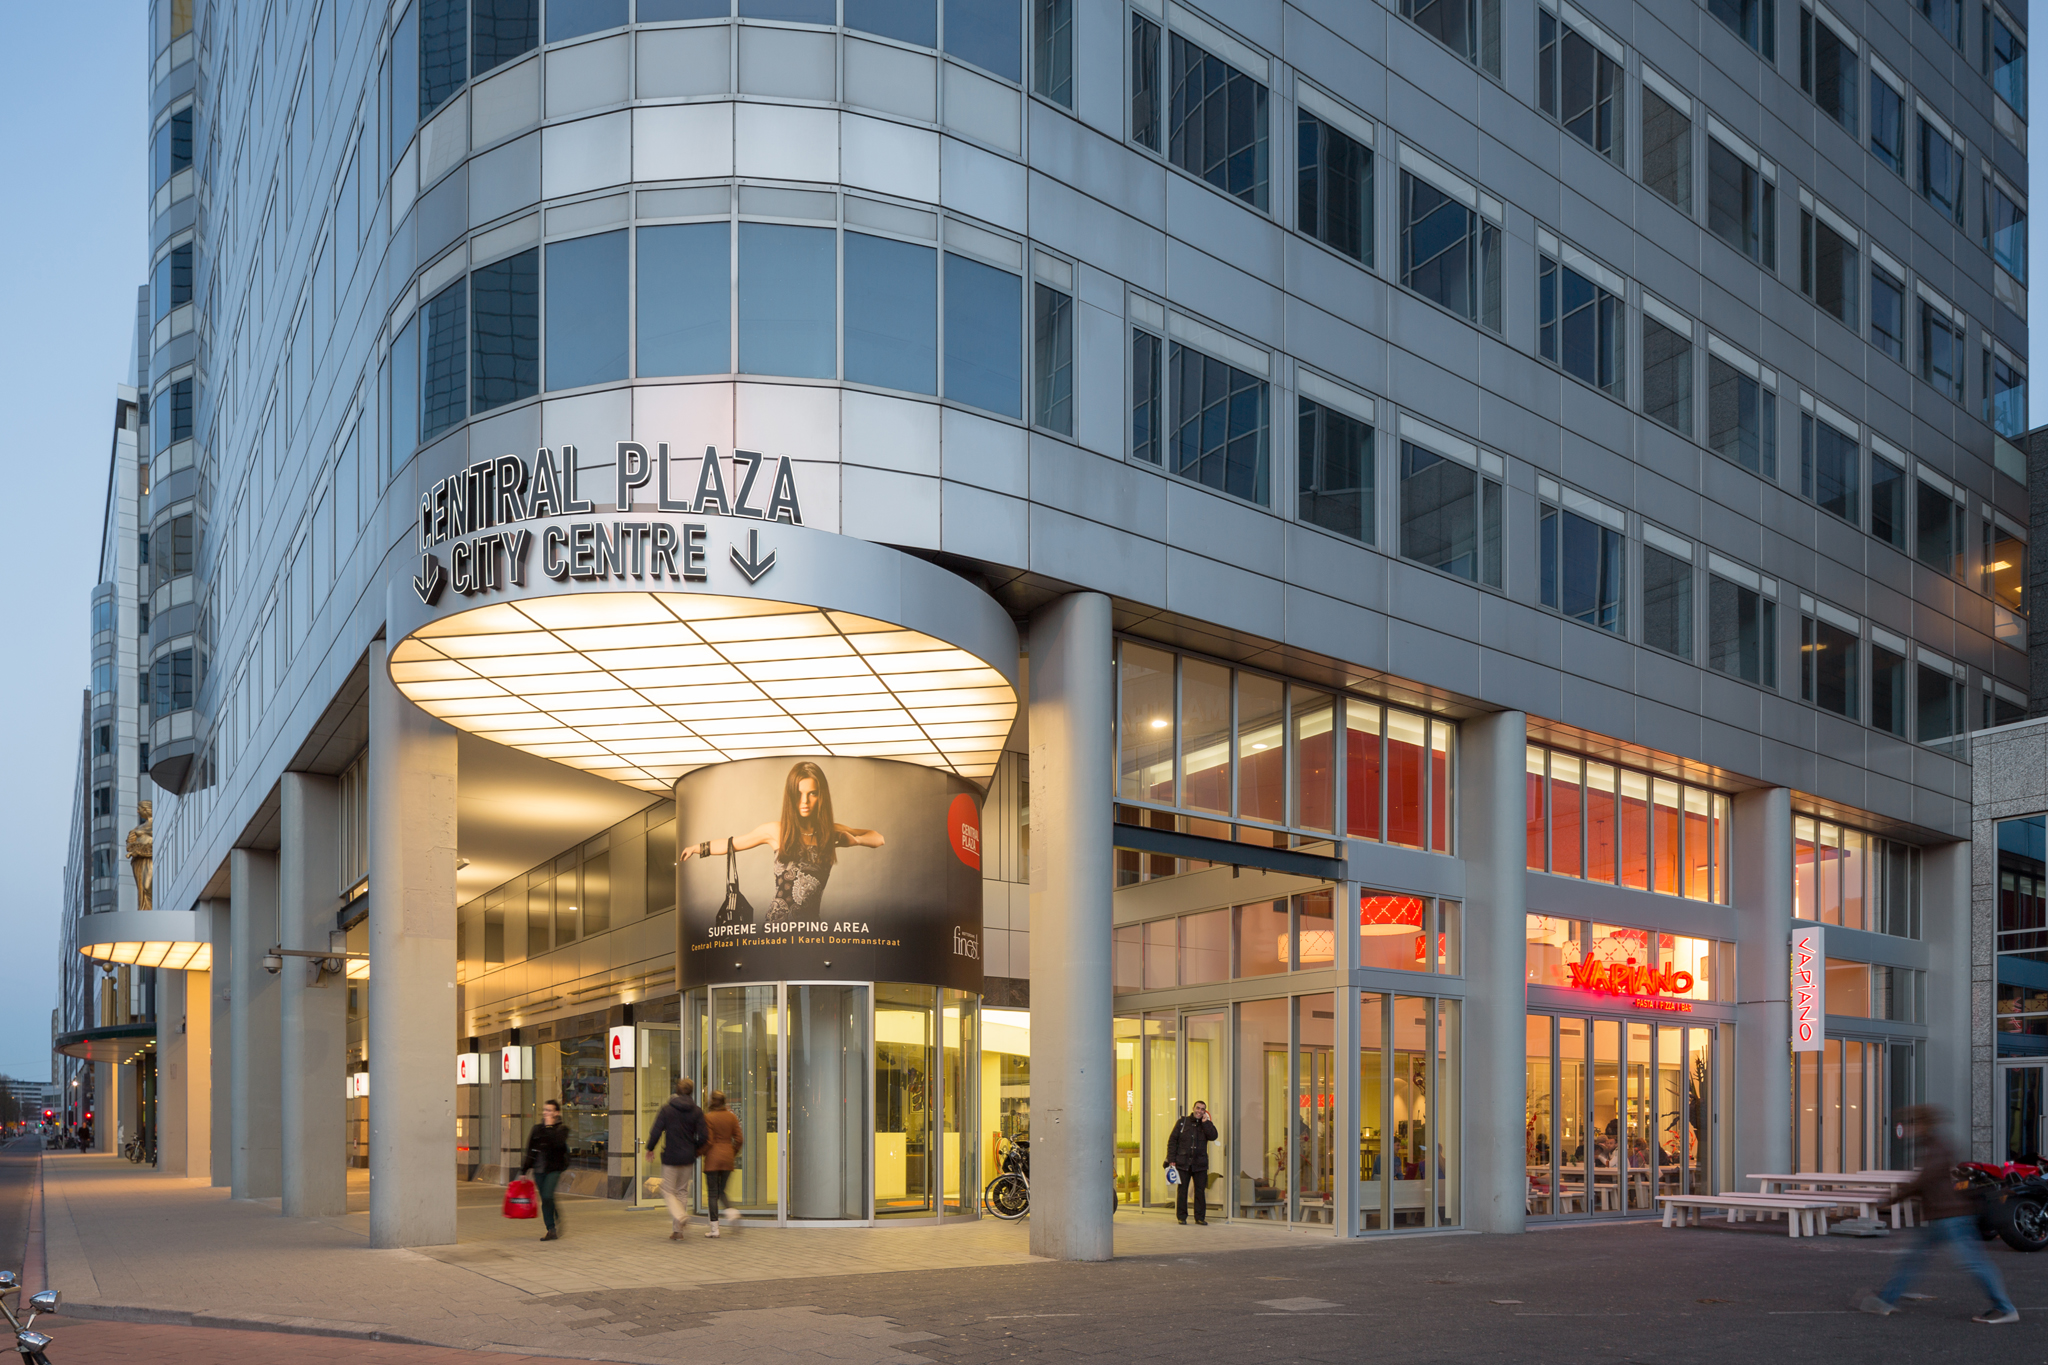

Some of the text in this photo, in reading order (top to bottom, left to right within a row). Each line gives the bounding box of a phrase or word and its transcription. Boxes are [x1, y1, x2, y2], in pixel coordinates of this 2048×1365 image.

[419, 440, 805, 553] CENTRAL PLAZA
[451, 521, 709, 597] CITY CENTRE
[962, 822, 980, 842] CENTRAL
[961, 834, 976, 852] PLAZA
[708, 921, 870, 938] SUPREME SHOPPING AREA
[691, 936, 900, 952] Central Plaza Kruiskade Karel Doormanstraat
[1635, 998, 1654, 1009] PASTA
[1680, 1002, 1693, 1012] BAR
